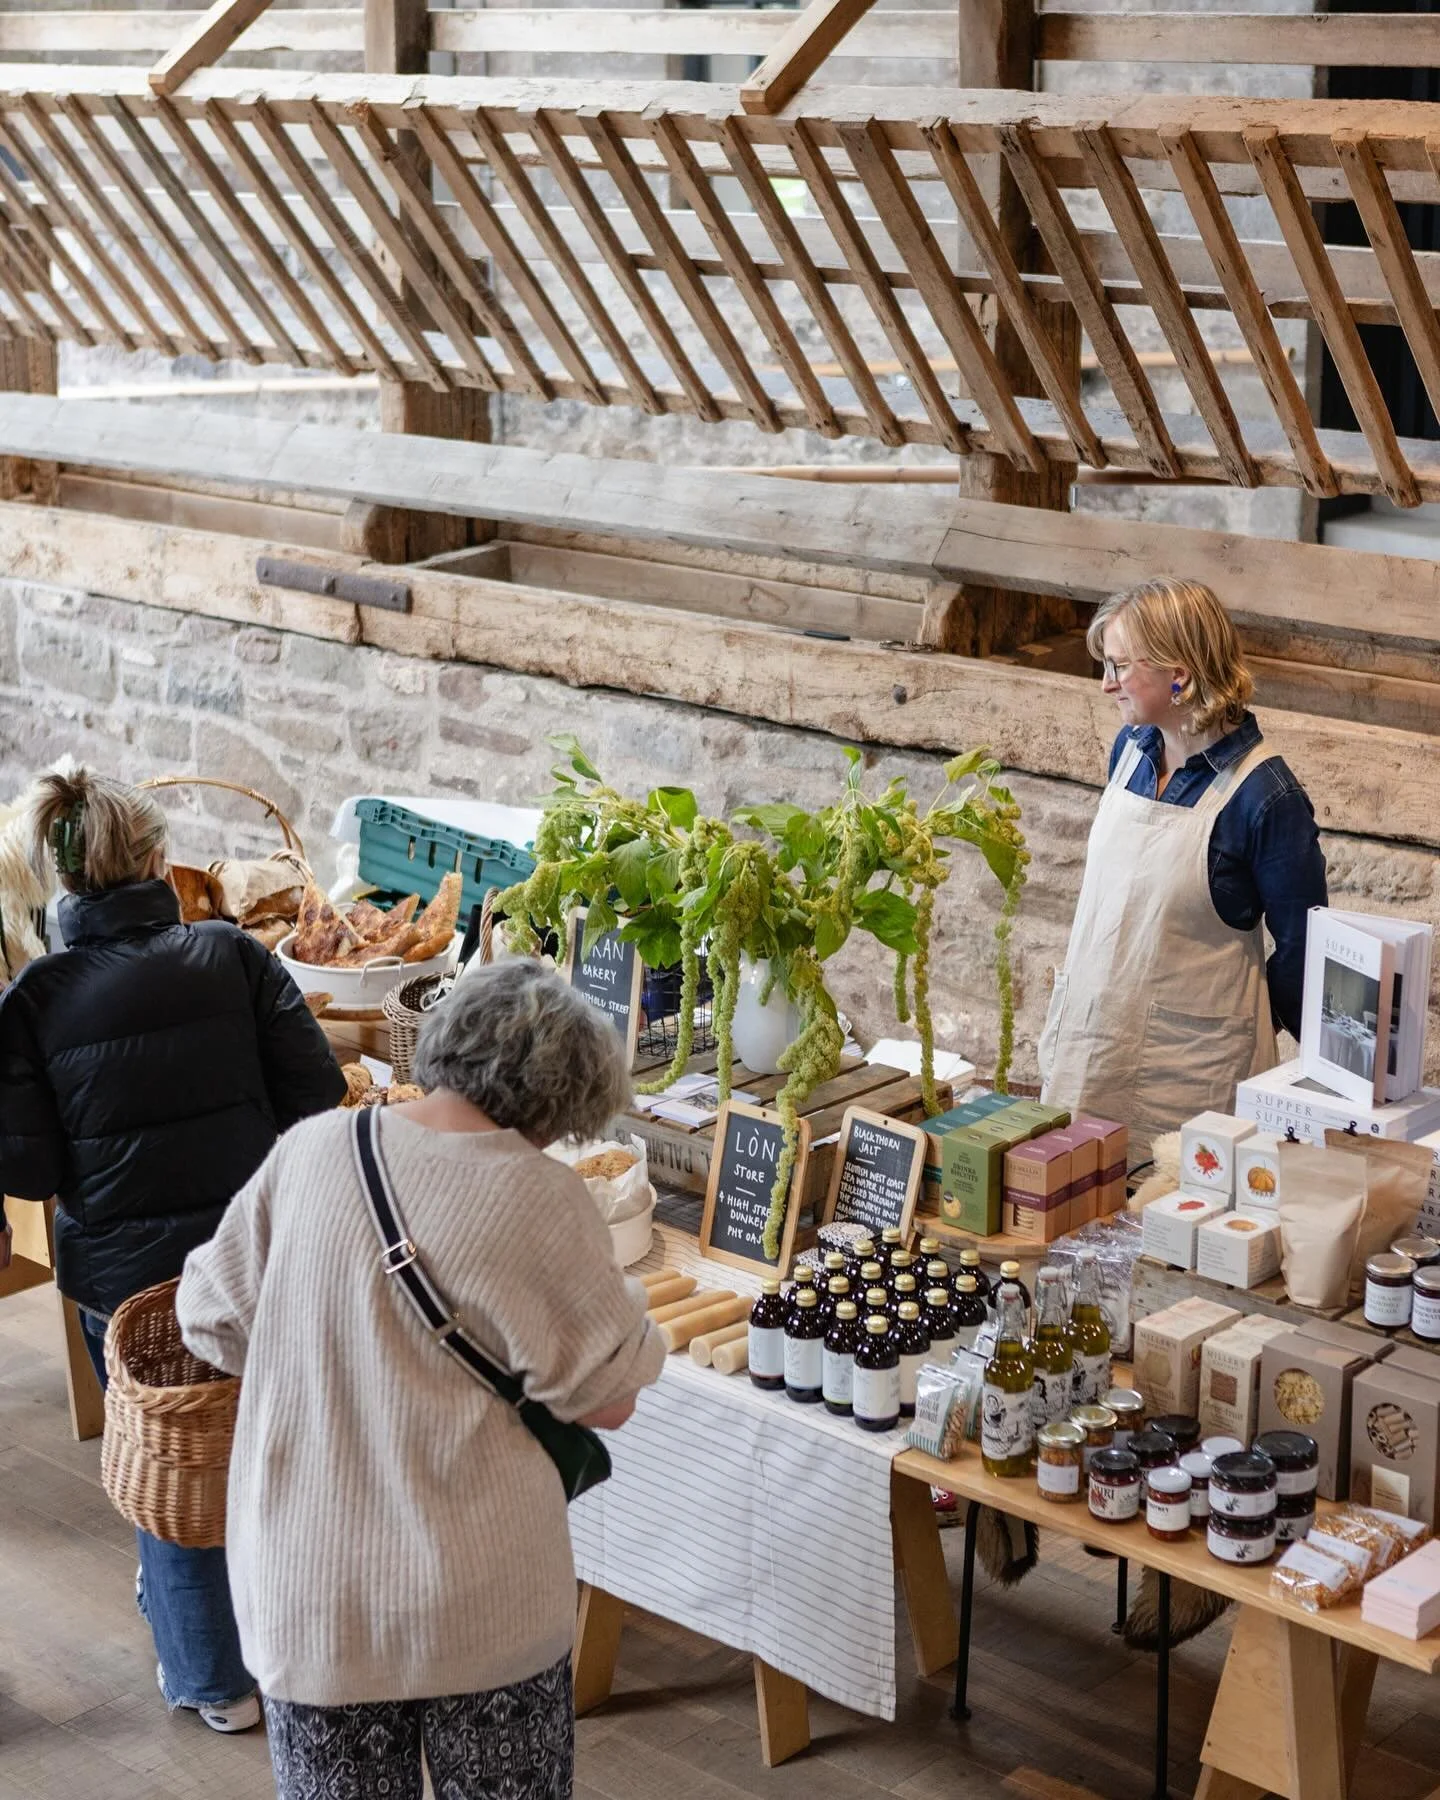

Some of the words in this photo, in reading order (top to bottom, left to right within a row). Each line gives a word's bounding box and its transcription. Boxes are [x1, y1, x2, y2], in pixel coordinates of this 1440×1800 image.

[1325, 938, 1365, 964] SUPPER
[582, 964, 617, 985] BAKERY
[608, 1000, 630, 1015] STREET
[1255, 1093, 1312, 1118] SUPPER
[1255, 1110, 1312, 1134] SUPPER
[736, 1128, 776, 1162] LÒN
[853, 1125, 900, 1151] BLACKTHORN
[858, 1142, 881, 1157] SALT
[733, 1163, 765, 1184] STORE
[842, 1171, 855, 1184] SEA
[856, 1176, 878, 1193] WATER
[878, 1185, 885, 1195] IS
[869, 1171, 886, 1184] WEST
[886, 1177, 906, 1191] COAST
[727, 1194, 750, 1211] HIGH
[752, 1203, 773, 1217] STRE
[839, 1191, 851, 1204] THE
[882, 1209, 900, 1222] ONLY
[868, 1191, 896, 1210] THROUGH
[730, 1208, 765, 1230] DUNKEL
